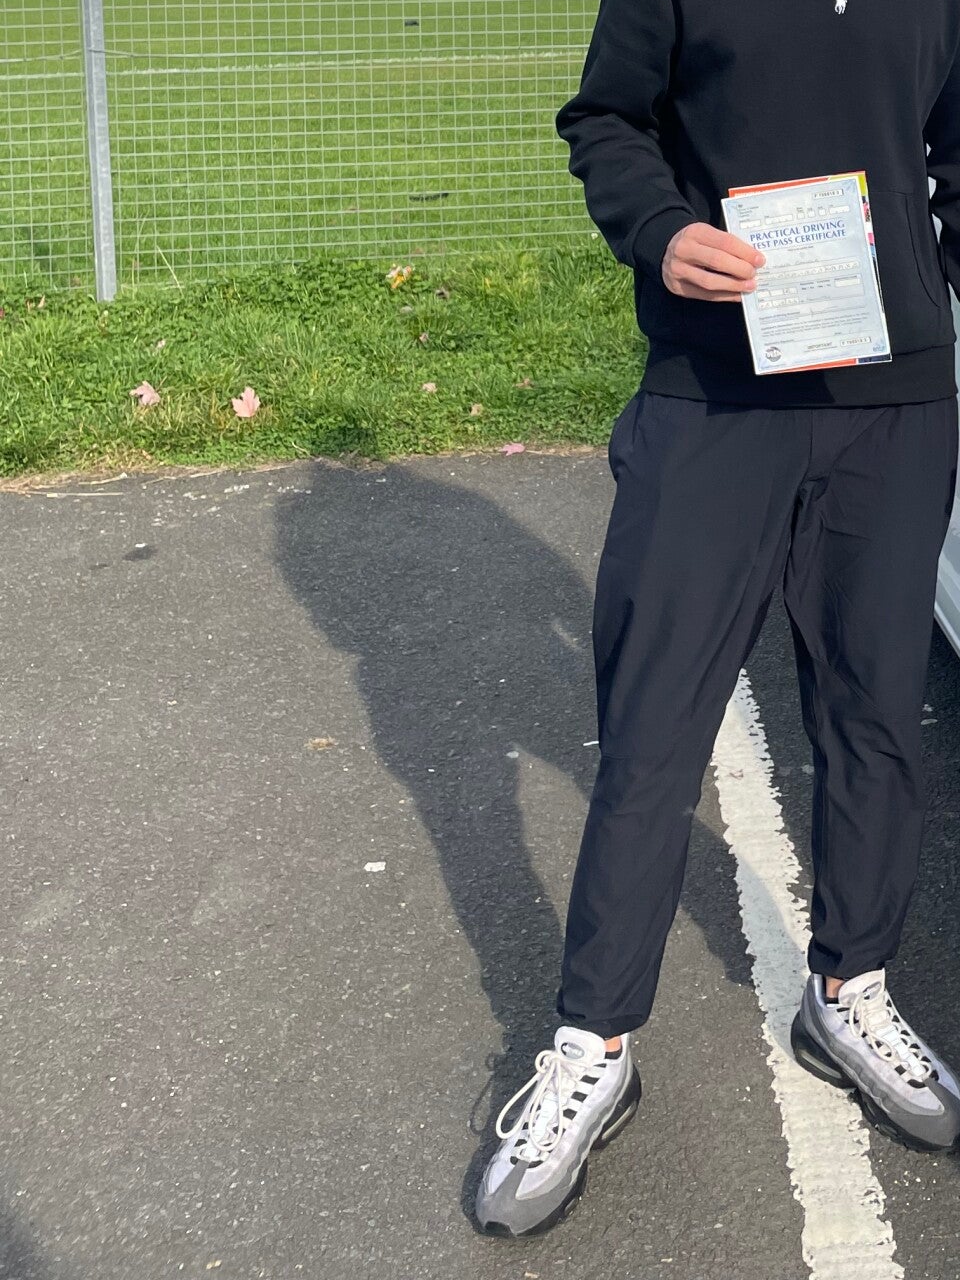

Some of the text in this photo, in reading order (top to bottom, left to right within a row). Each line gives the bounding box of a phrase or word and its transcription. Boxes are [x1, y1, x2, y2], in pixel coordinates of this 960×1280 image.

[750, 220, 845, 242] PRACTICAL DRIVING
[752, 229, 847, 250] TEST PASS CERTIFICATE
